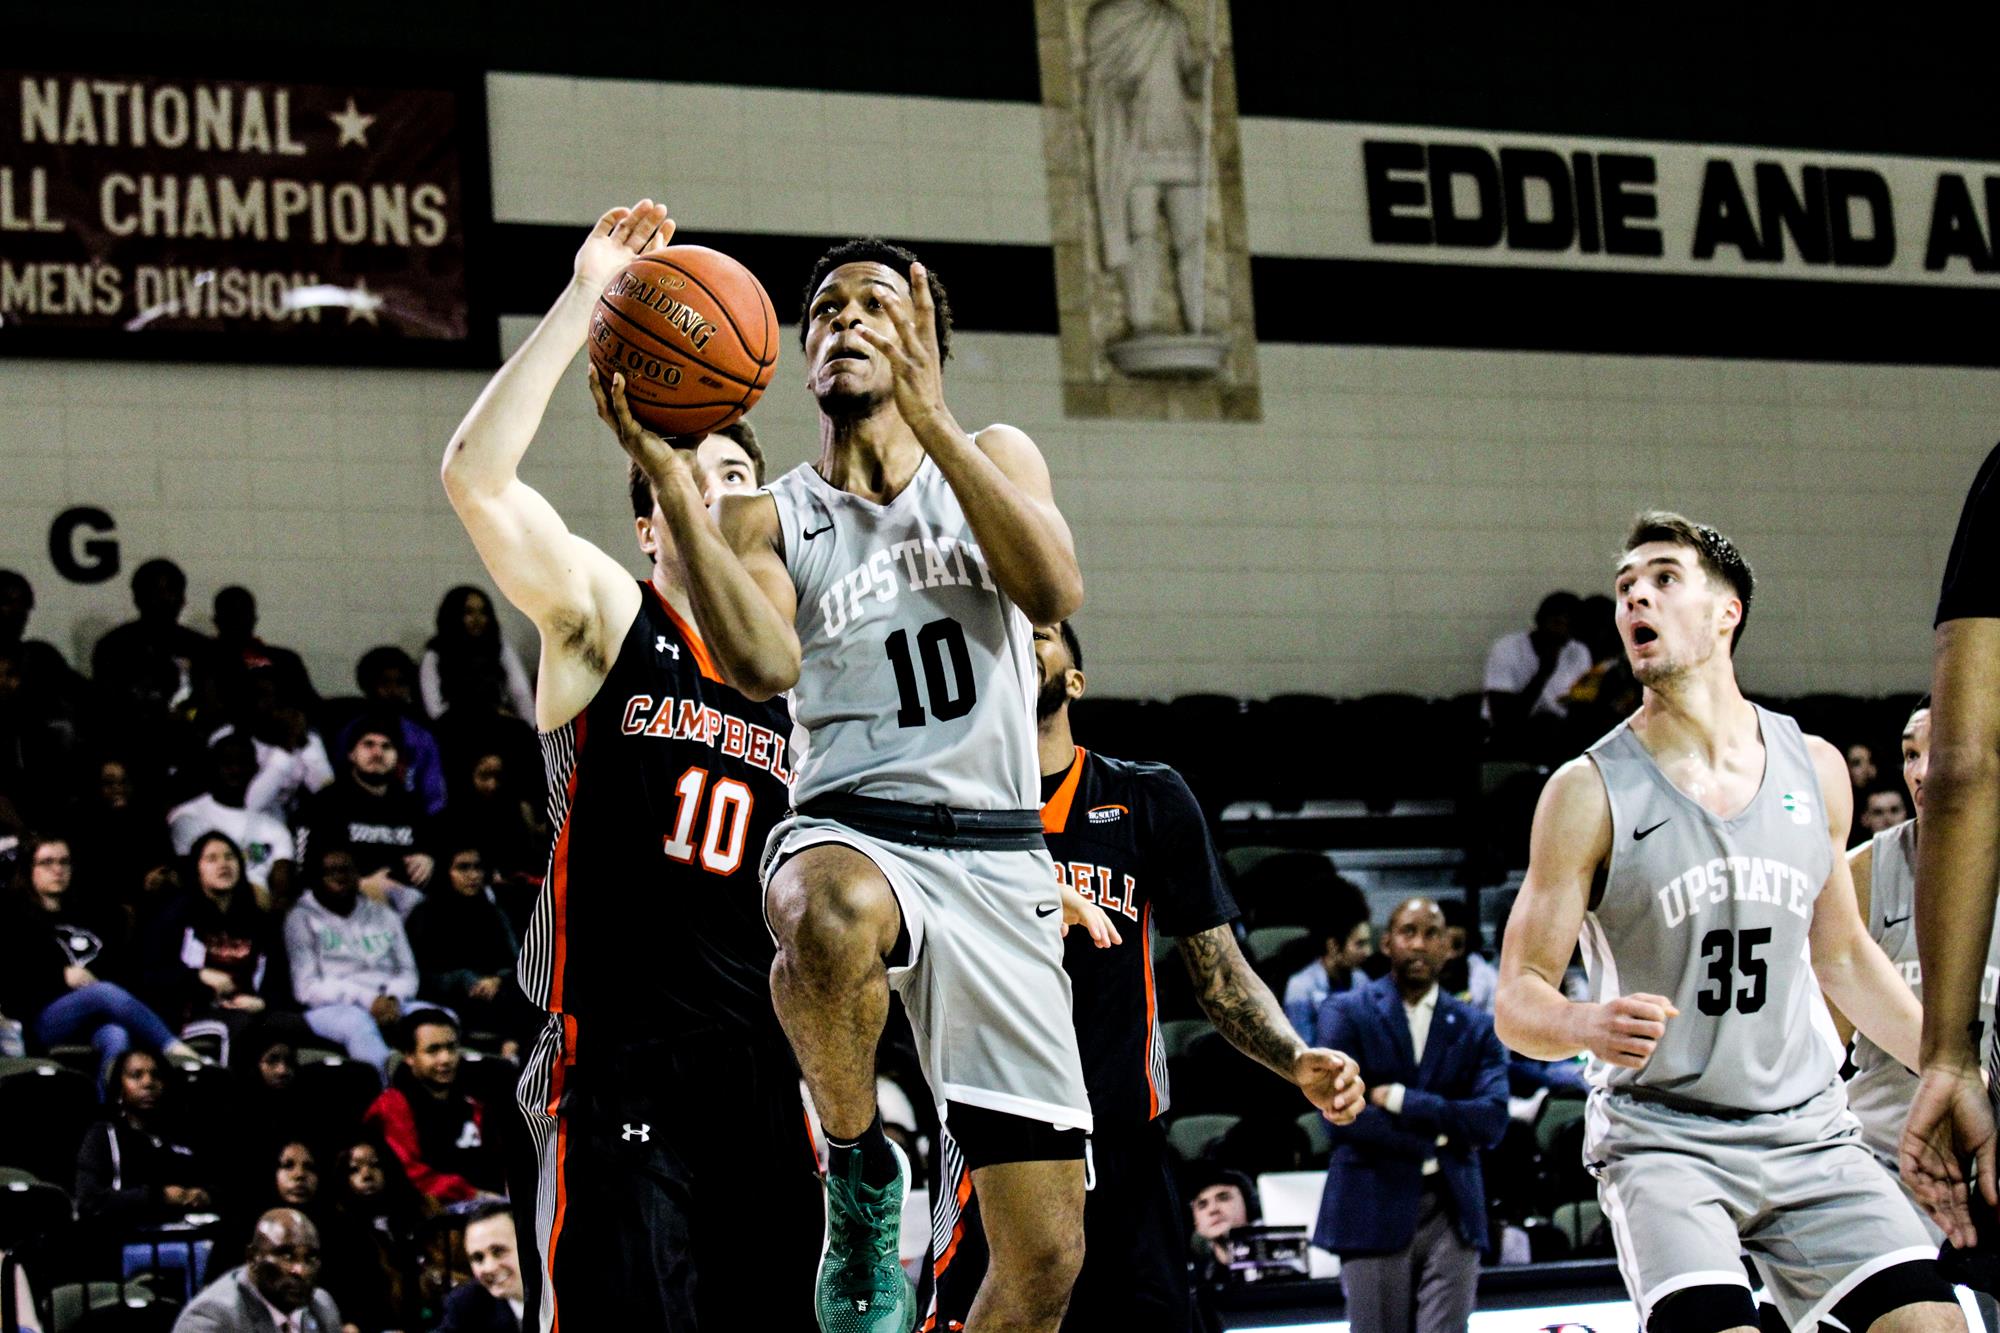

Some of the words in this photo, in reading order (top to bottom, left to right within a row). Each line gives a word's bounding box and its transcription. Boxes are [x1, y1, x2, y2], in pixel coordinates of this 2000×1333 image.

[20, 77, 306, 155] NATIONAL
[101, 173, 448, 246] CHAMPIONS
[1363, 139, 1664, 257] EDDIE
[1691, 159, 1897, 268] AND
[1924, 172, 2000, 273] A
[0, 261, 123, 315] MENS
[135, 266, 321, 323] DIVISION
[607, 271, 717, 352] SPALDING
[48, 507, 120, 584] G
[884, 617, 977, 728] 10
[663, 766, 754, 876] 10
[1658, 856, 1808, 929] UPSTATE
[1697, 927, 1772, 1016] 35
